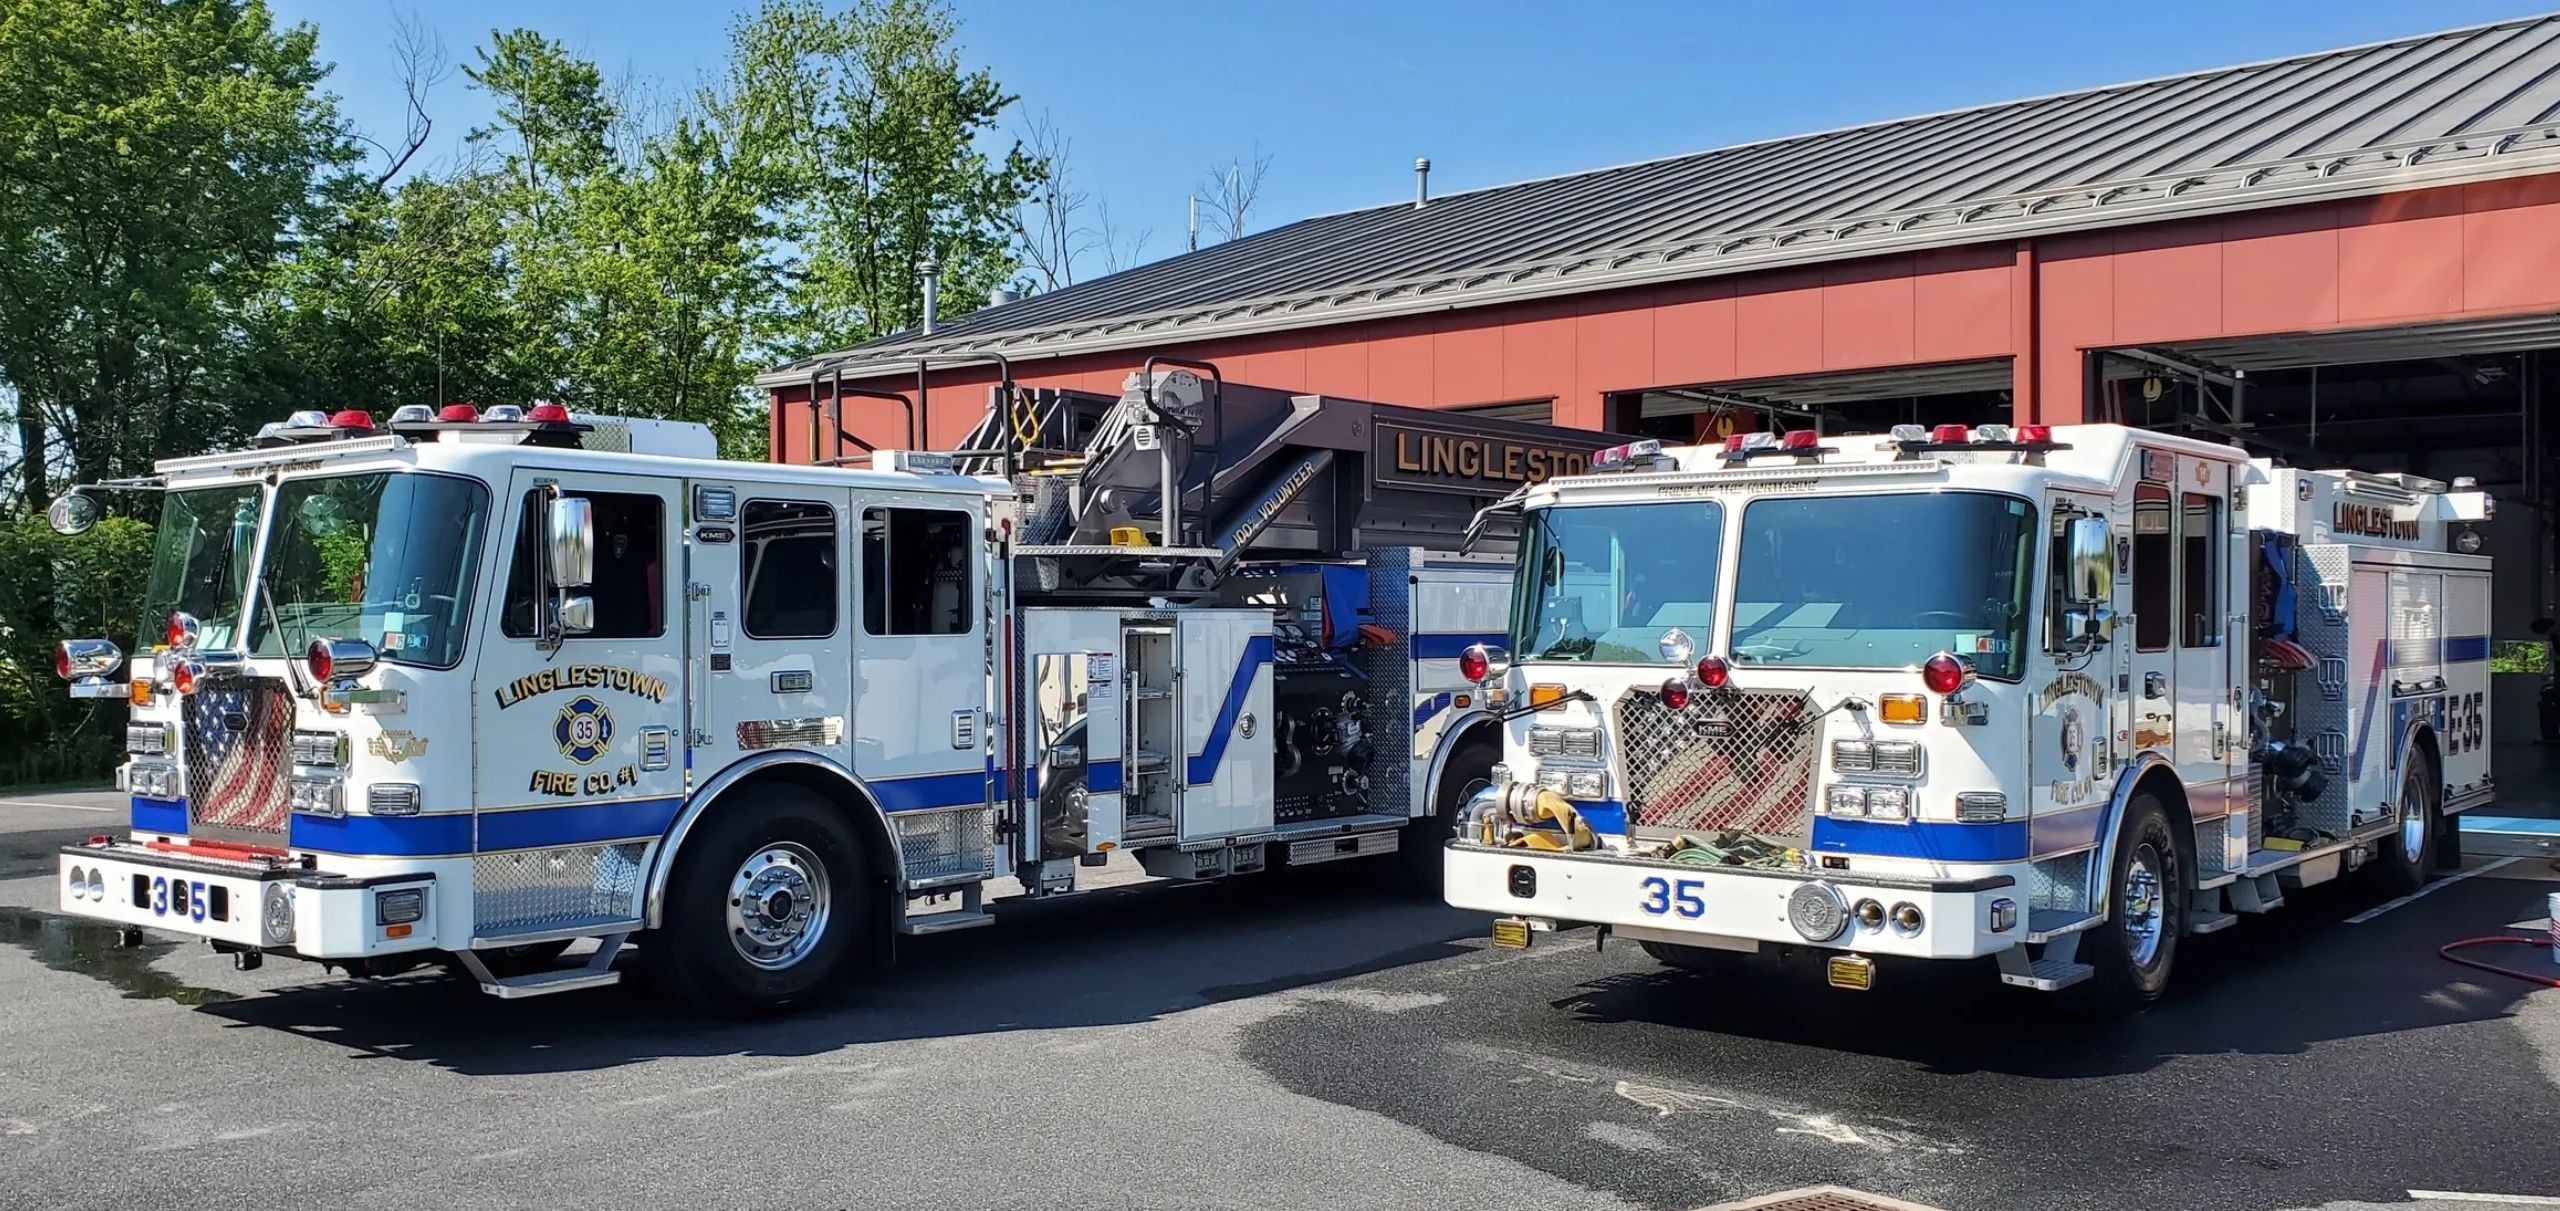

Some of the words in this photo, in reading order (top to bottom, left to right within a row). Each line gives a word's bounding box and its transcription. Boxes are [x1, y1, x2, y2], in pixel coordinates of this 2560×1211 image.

[1396, 432, 1590, 482] LINGLESTO
[1232, 516, 1259, 547] 100%
[1257, 461, 1315, 520] VOLUNTEER
[1658, 485, 1694, 497] PRIDE
[1697, 484, 1716, 496] OF
[1719, 483, 1743, 495] THE
[1748, 480, 1819, 494] NORTHSIDE
[2333, 501, 2420, 541] LINGLESTOWN
[495, 665, 668, 711] LINGLESTOWN
[2038, 672, 2104, 715] LINGLESTOWN
[576, 720, 593, 740] 35
[1698, 725, 1728, 735] KME
[2449, 691, 2483, 754] E-35
[529, 769, 579, 797] FIRE
[617, 763, 639, 787] #1
[1639, 876, 1705, 920] 35
